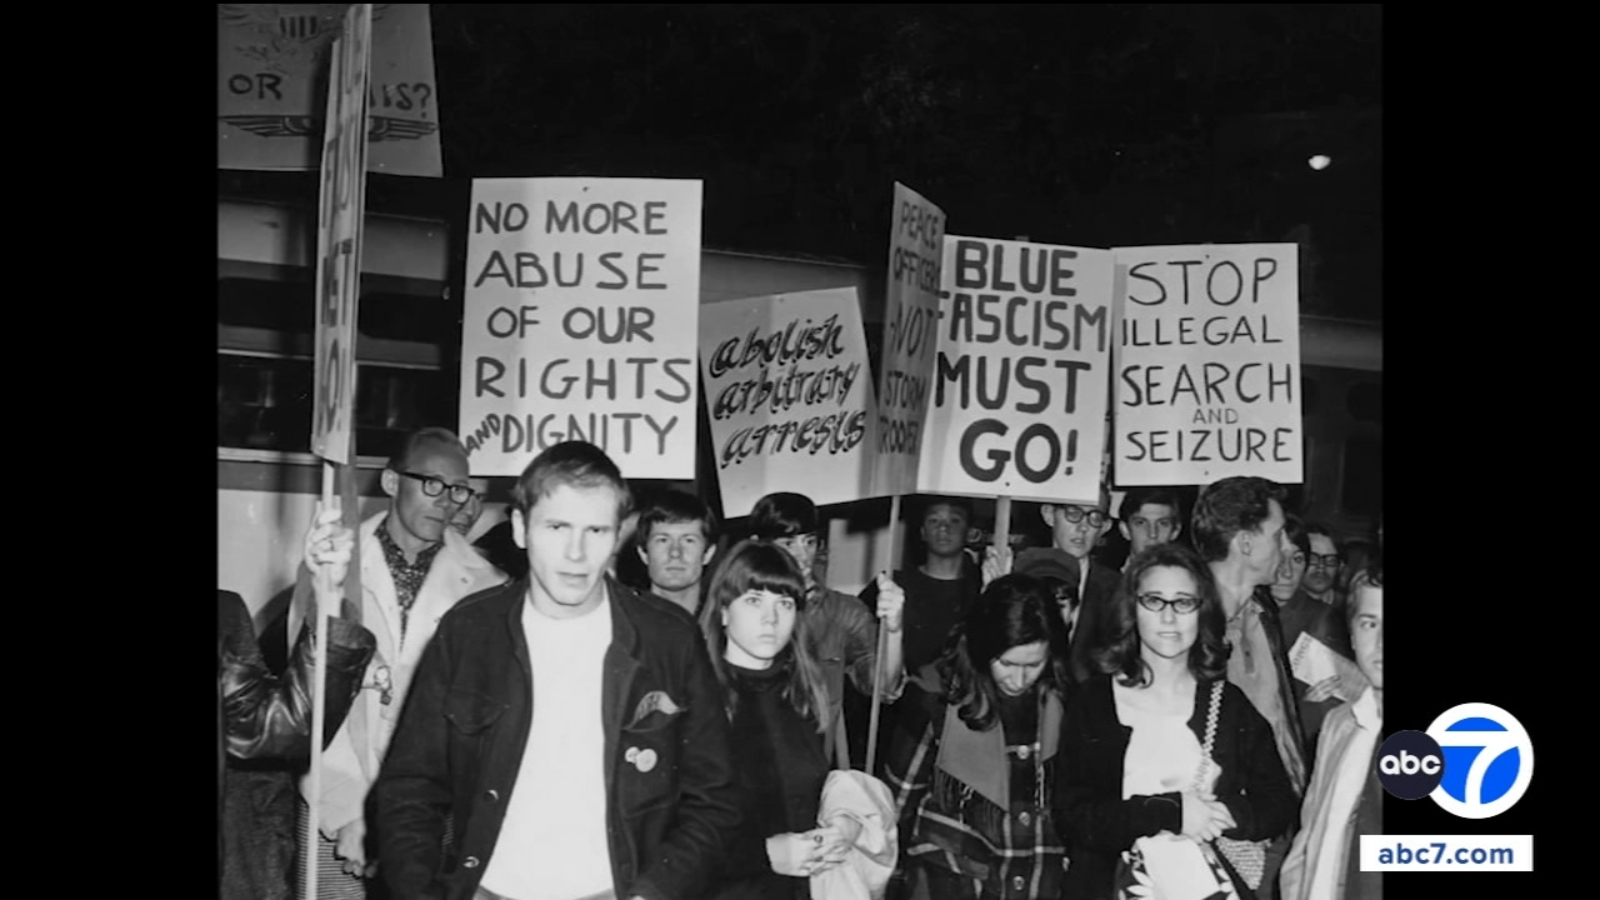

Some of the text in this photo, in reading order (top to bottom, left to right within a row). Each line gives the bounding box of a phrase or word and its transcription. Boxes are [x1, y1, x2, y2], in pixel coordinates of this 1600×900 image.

[228, 73, 283, 100] OR
[475, 200, 668, 235] NO MORE
[899, 201, 939, 250] PEACE
[474, 250, 667, 290] ABUSE
[956, 239, 1078, 297] BLUE
[1129, 257, 1277, 306] STOP
[487, 305, 655, 344] OF OUR
[939, 290, 1107, 352] ASCISM
[1122, 314, 1284, 346] ILLEGAL
[709, 313, 845, 378] abolish
[476, 355, 692, 404] RIGHTS
[713, 361, 861, 421] arbitrary
[884, 370, 927, 412] STORM
[935, 351, 1092, 414] MUST
[1121, 362, 1292, 407] SEARCH
[460, 412, 679, 457] AND DIGNITY
[720, 410, 868, 469] arrests
[1192, 408, 1239, 424] AND
[959, 417, 1078, 484] GO!
[1125, 427, 1293, 462] SEIZURE
